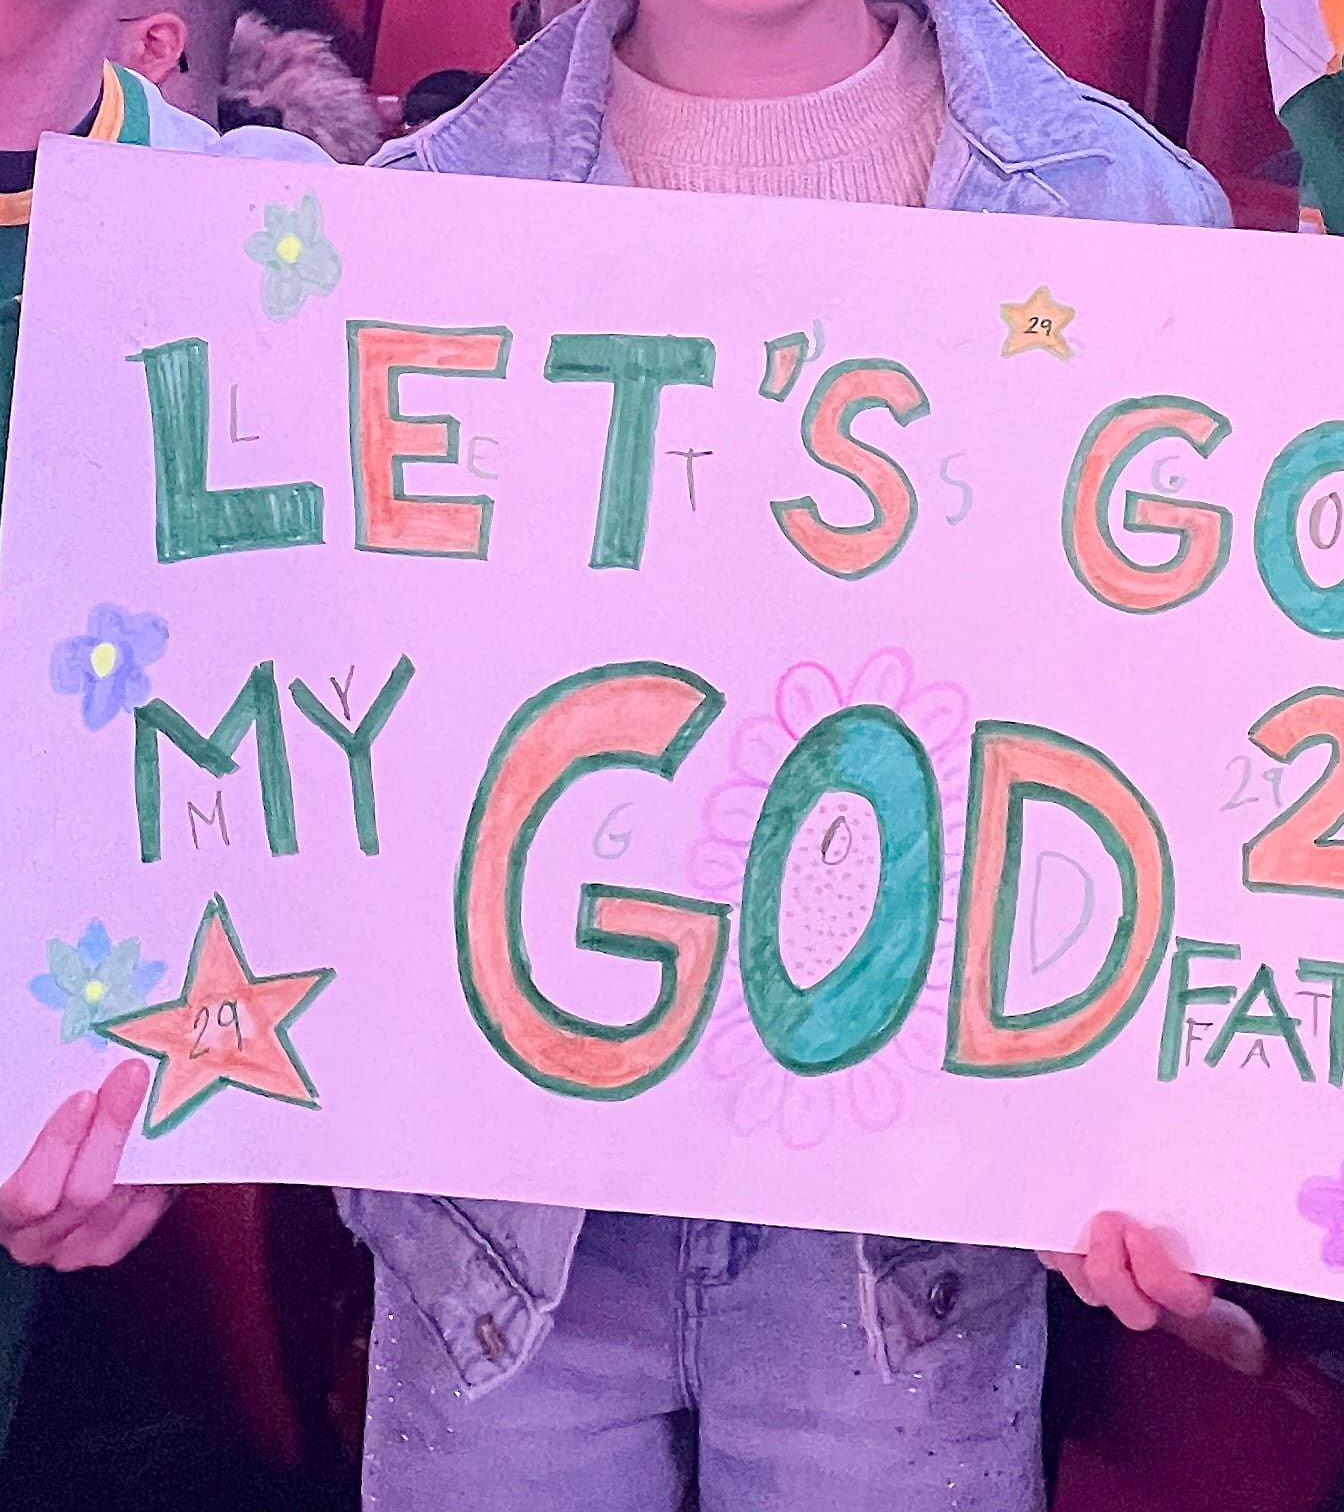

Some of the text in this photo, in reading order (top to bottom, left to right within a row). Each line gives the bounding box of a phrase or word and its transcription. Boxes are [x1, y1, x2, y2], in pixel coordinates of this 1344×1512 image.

[1024, 317, 1052, 336] 29
[125, 320, 930, 580] LET'S
[1220, 754, 1284, 811] 29
[134, 654, 1175, 1102] MY GOD
[189, 1000, 242, 1059] 29
